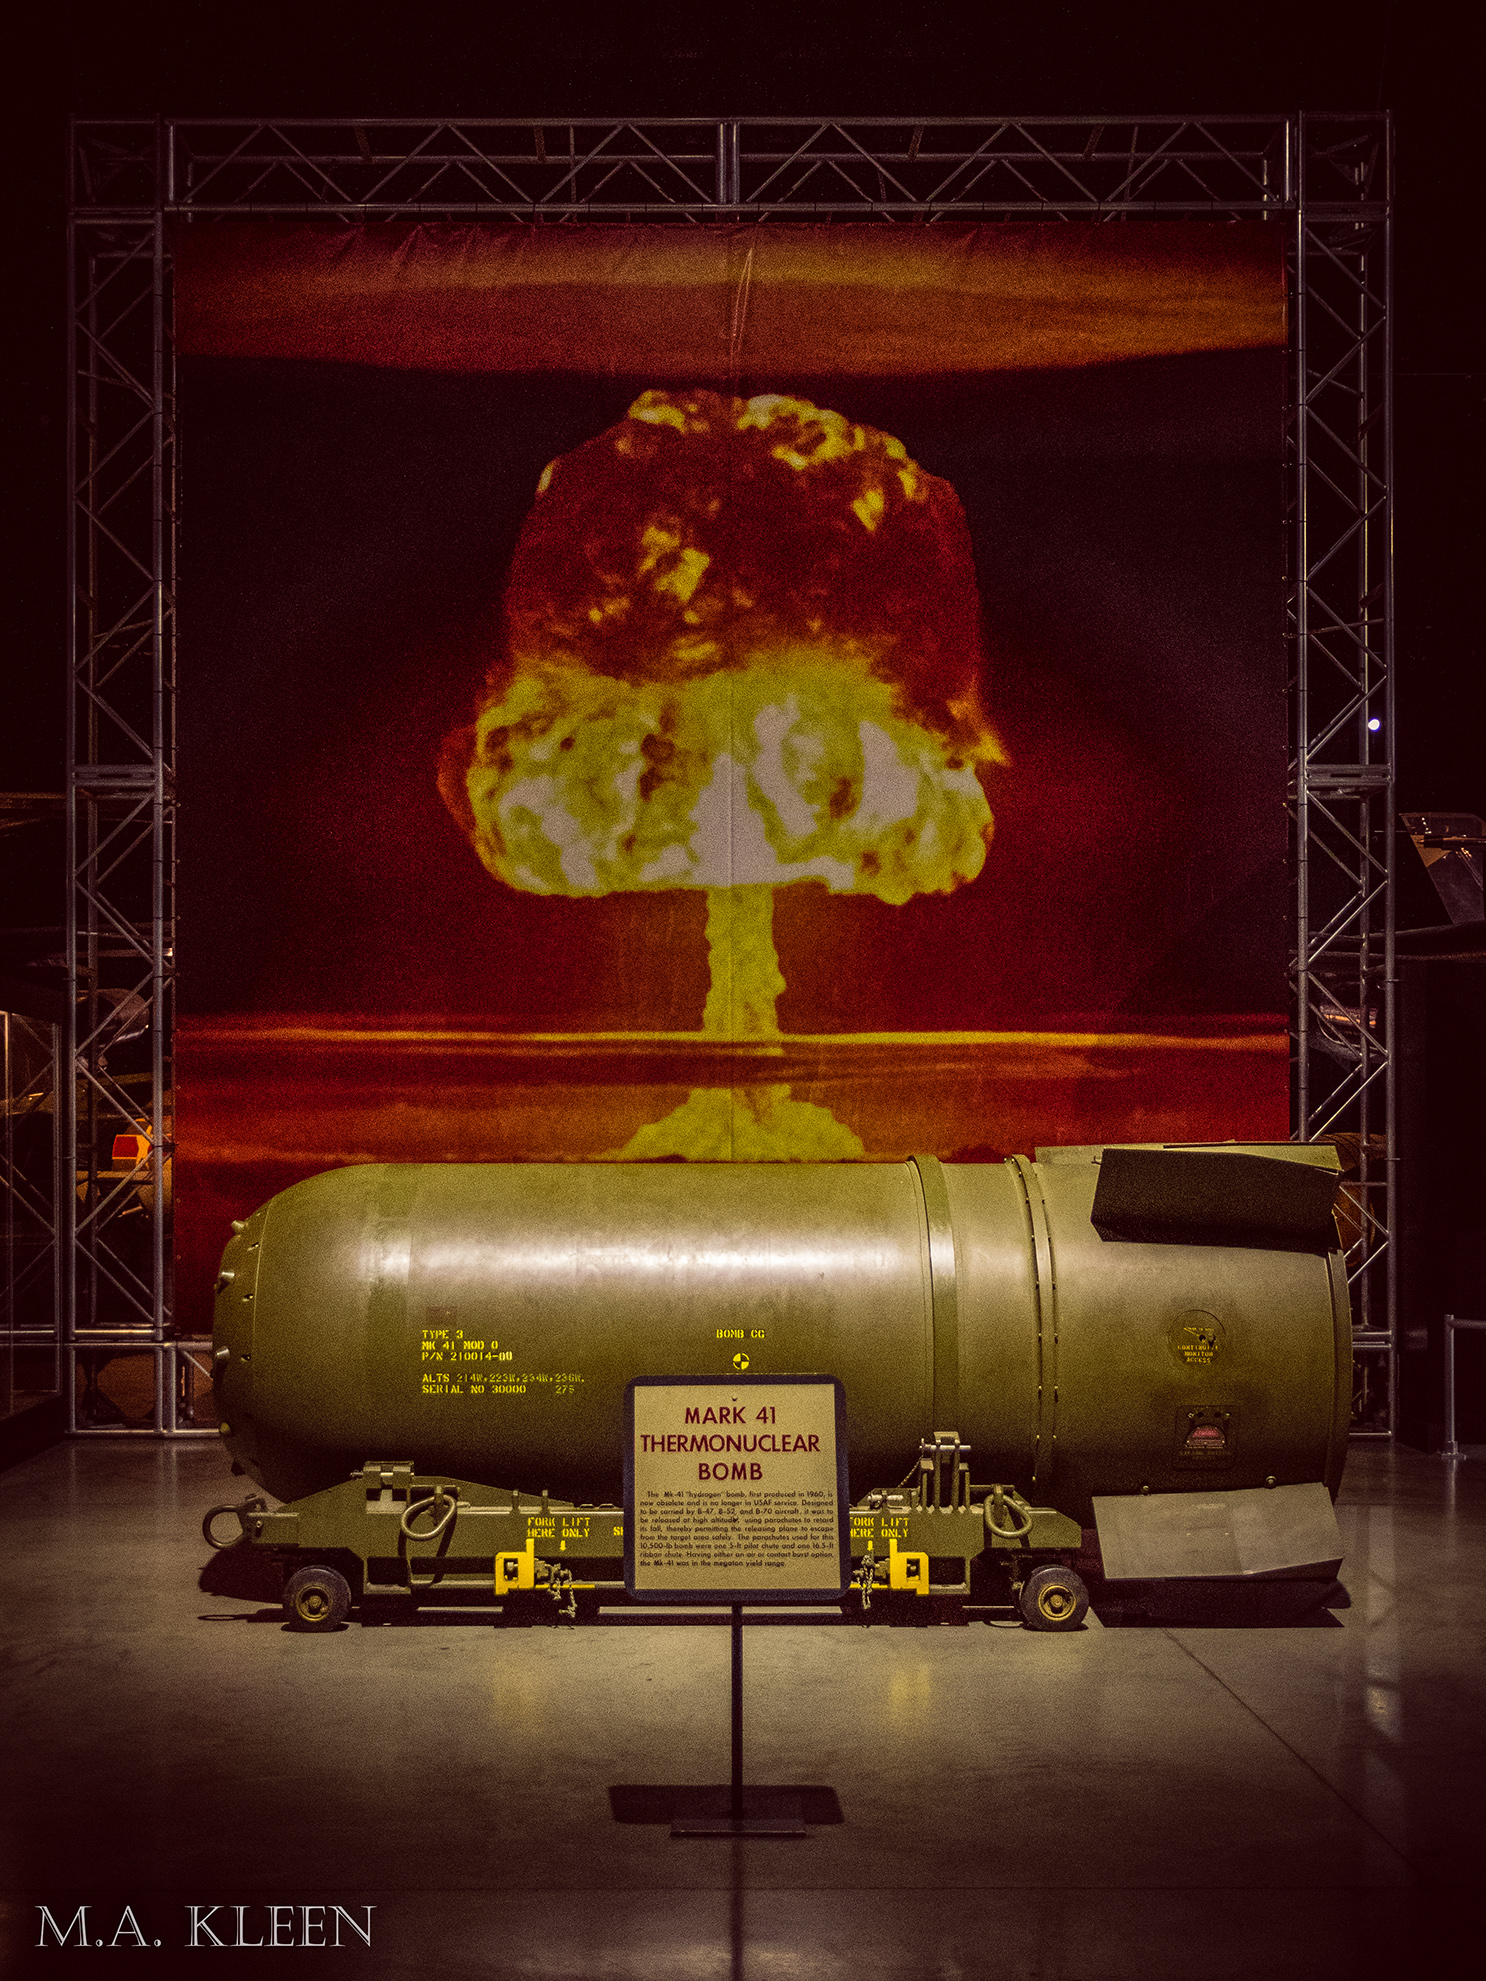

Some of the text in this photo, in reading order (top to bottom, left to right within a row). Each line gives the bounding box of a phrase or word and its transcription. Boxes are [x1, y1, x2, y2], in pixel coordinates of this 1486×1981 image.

[422, 1330, 464, 1339] TYPE 3
[716, 1329, 765, 1338] BOMB CG
[422, 1340, 436, 1350] MK
[442, 1340, 455, 1350] 41
[463, 1340, 484, 1350] MOD
[422, 1351, 513, 1361] P/N 210014-00
[422, 1373, 450, 1382] ALTS
[422, 1385, 464, 1394] SERIAL
[470, 1385, 485, 1394] NO
[492, 1385, 526, 1394] 30000
[685, 1406, 776, 1424] MARK 41
[640, 1434, 821, 1452] THERMONUCLEAR
[698, 1462, 763, 1480] BOMB
[527, 1517, 590, 1526] FORK LIFT
[881, 1517, 909, 1526] LIFT
[527, 1528, 590, 1538] HERE ONLY
[881, 1528, 908, 1537] ONLY
